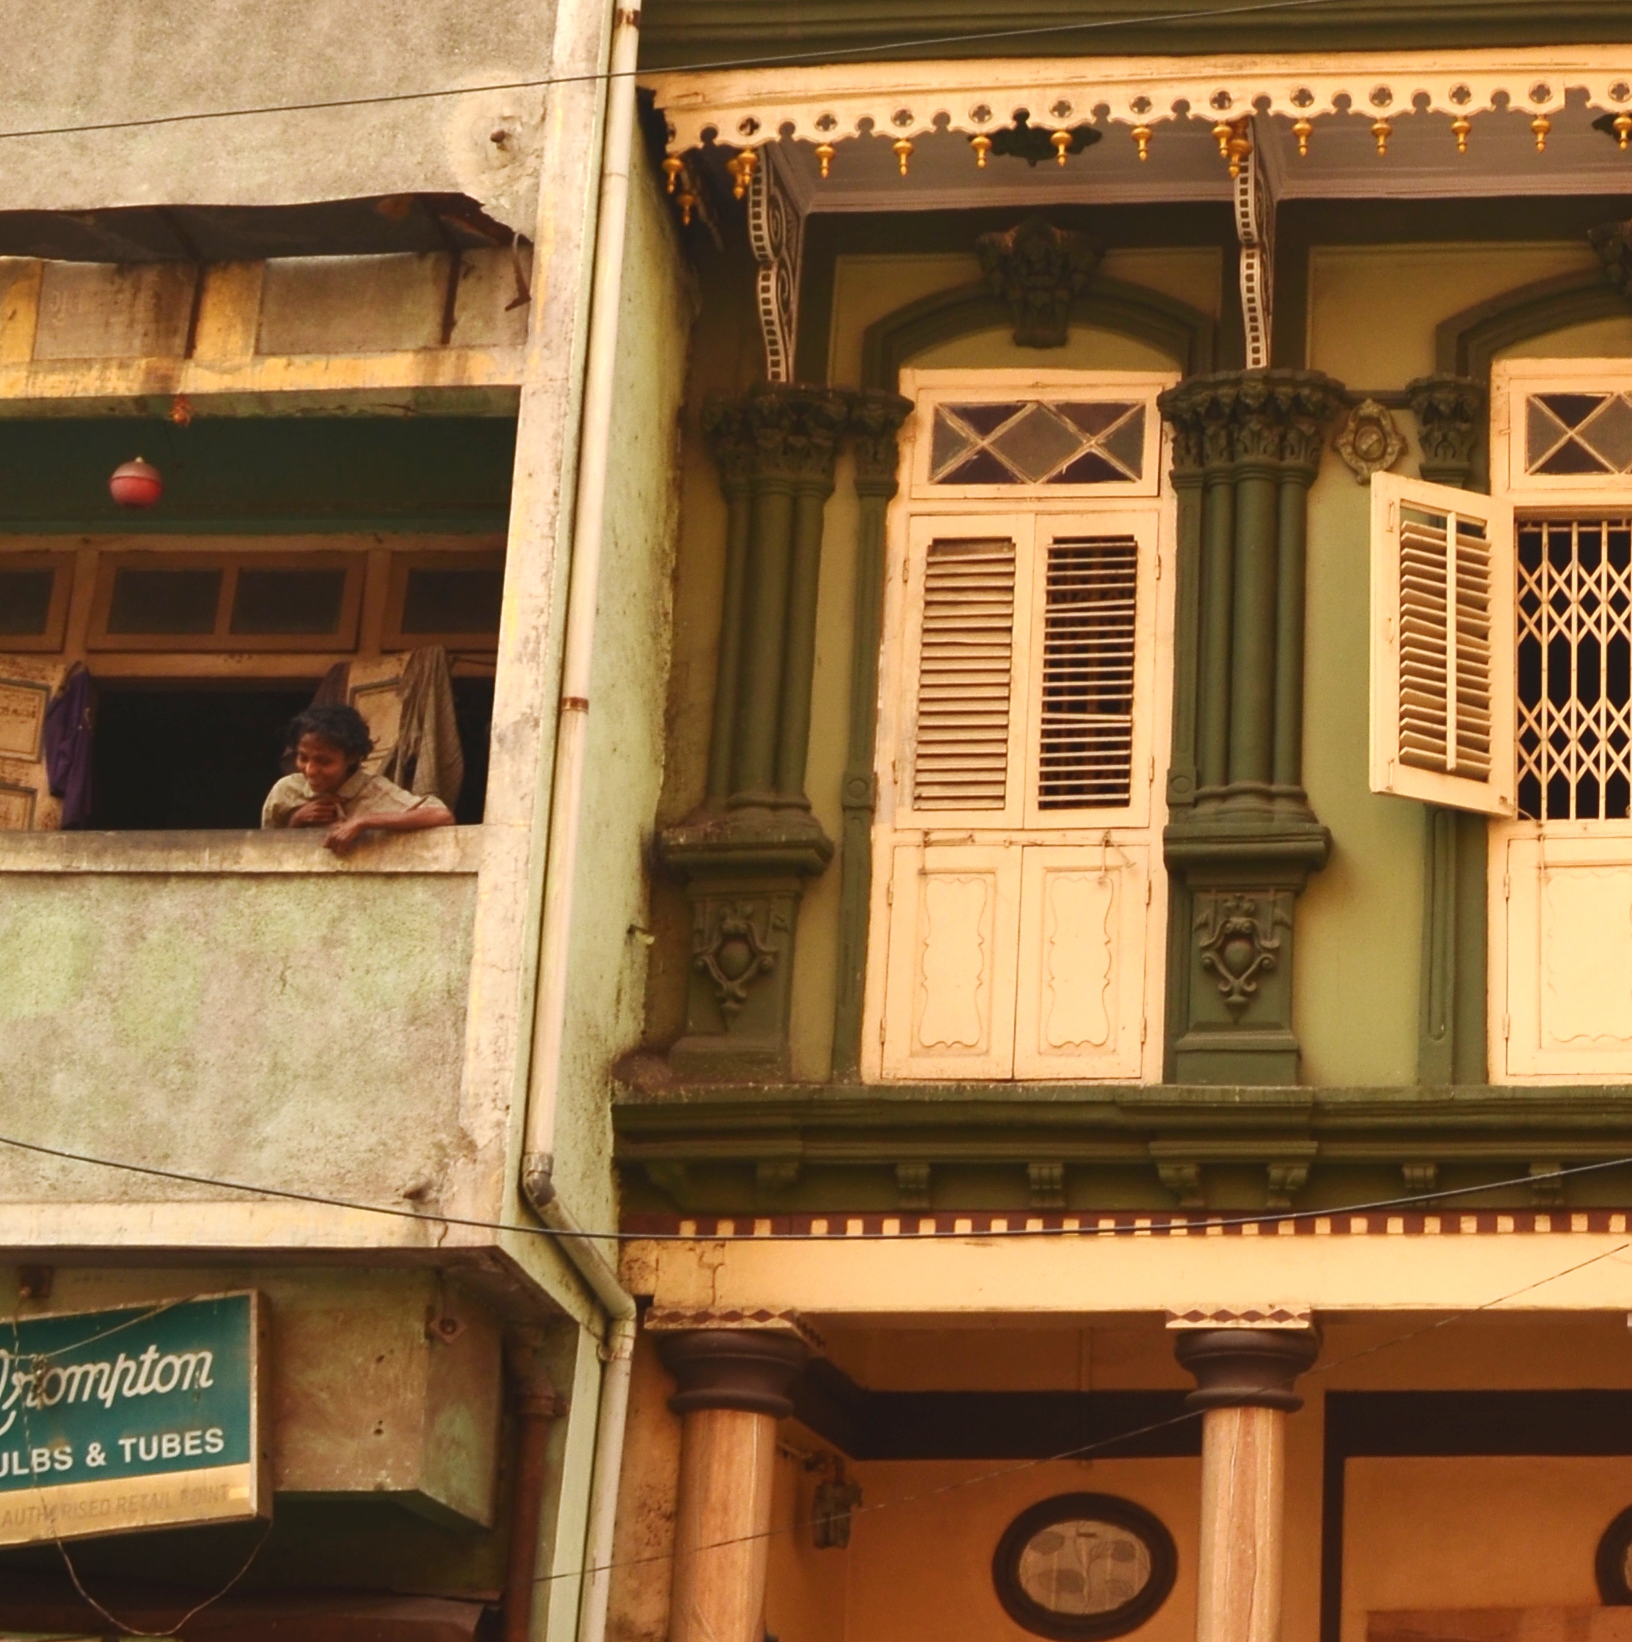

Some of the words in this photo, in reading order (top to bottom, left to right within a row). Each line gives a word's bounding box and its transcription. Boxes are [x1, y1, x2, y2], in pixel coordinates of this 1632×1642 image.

[86, 1443, 106, 1467] &
[118, 1428, 224, 1463] TUBES
[118, 1492, 171, 1515] RETAIL
[180, 1484, 229, 1505] POINT
